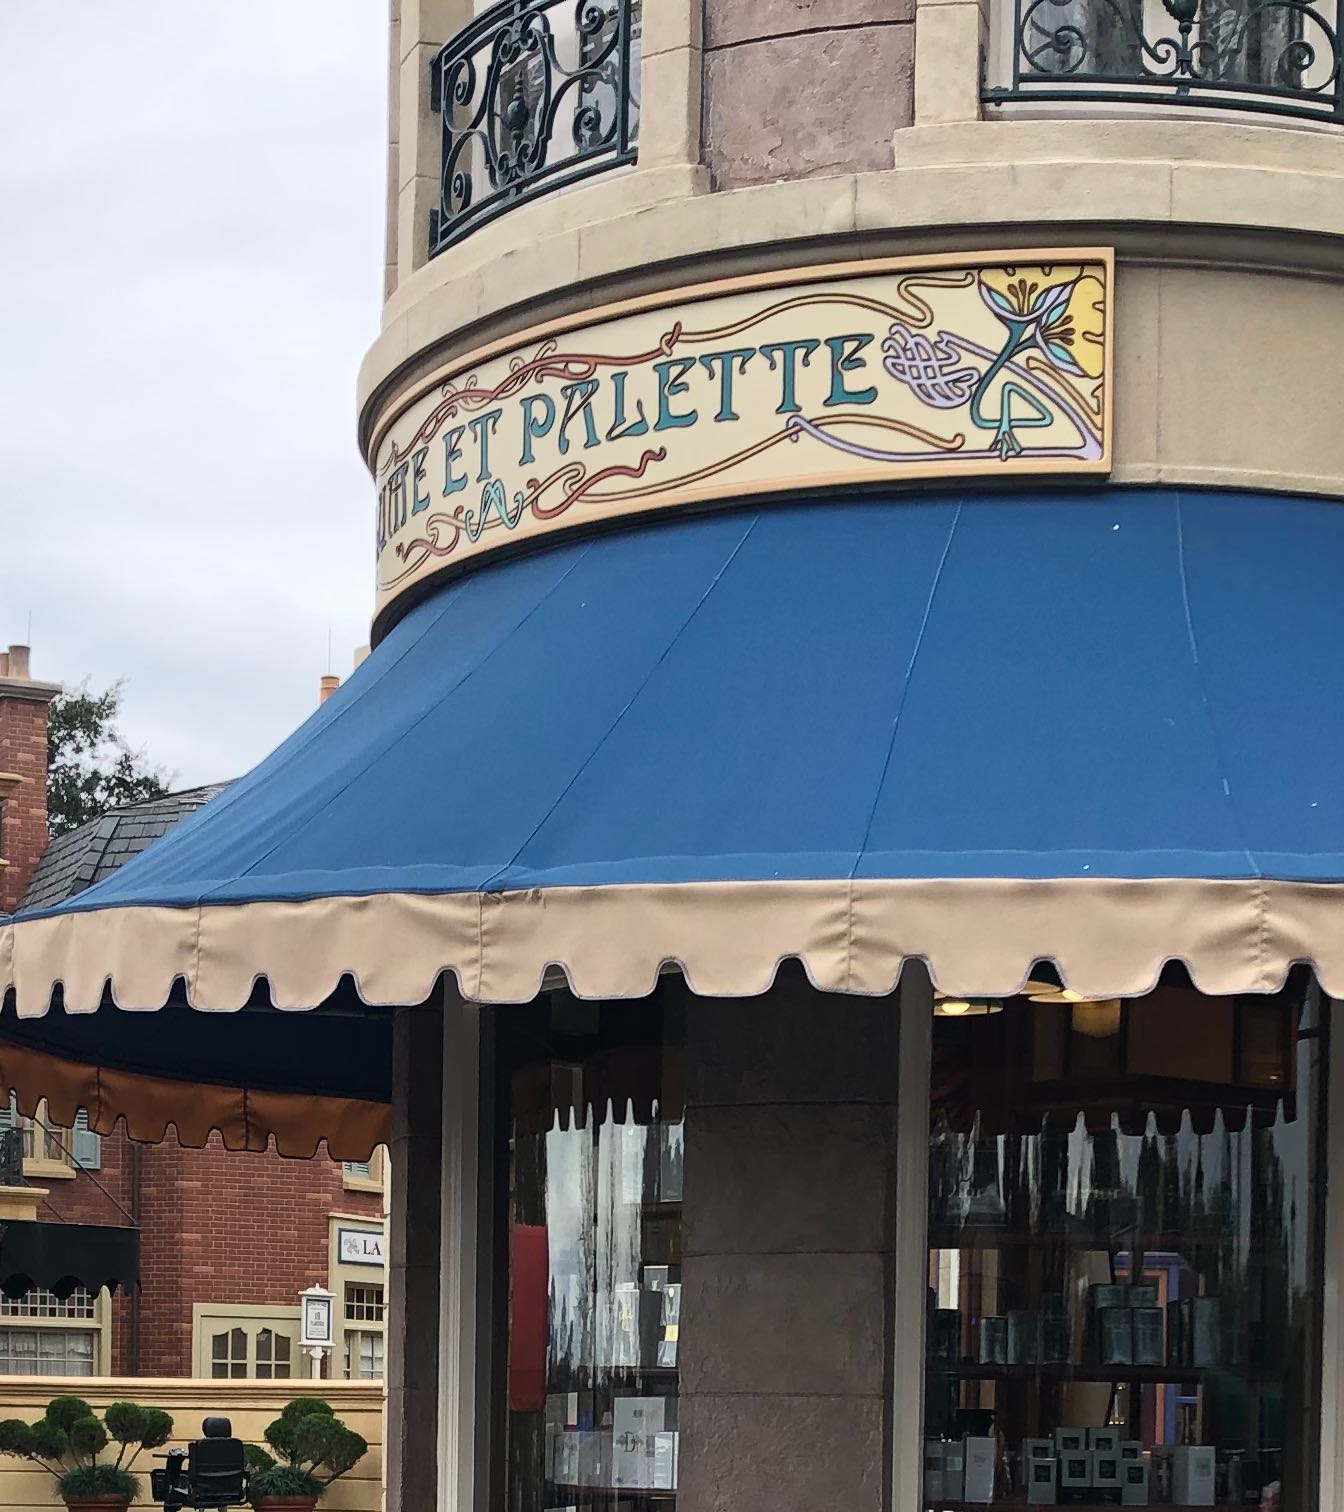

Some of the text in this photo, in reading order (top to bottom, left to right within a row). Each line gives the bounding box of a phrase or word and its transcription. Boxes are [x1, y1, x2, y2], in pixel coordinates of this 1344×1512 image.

[442, 408, 503, 497] ET
[519, 333, 878, 466] PALETTE
[362, 1239, 382, 1256] LA
